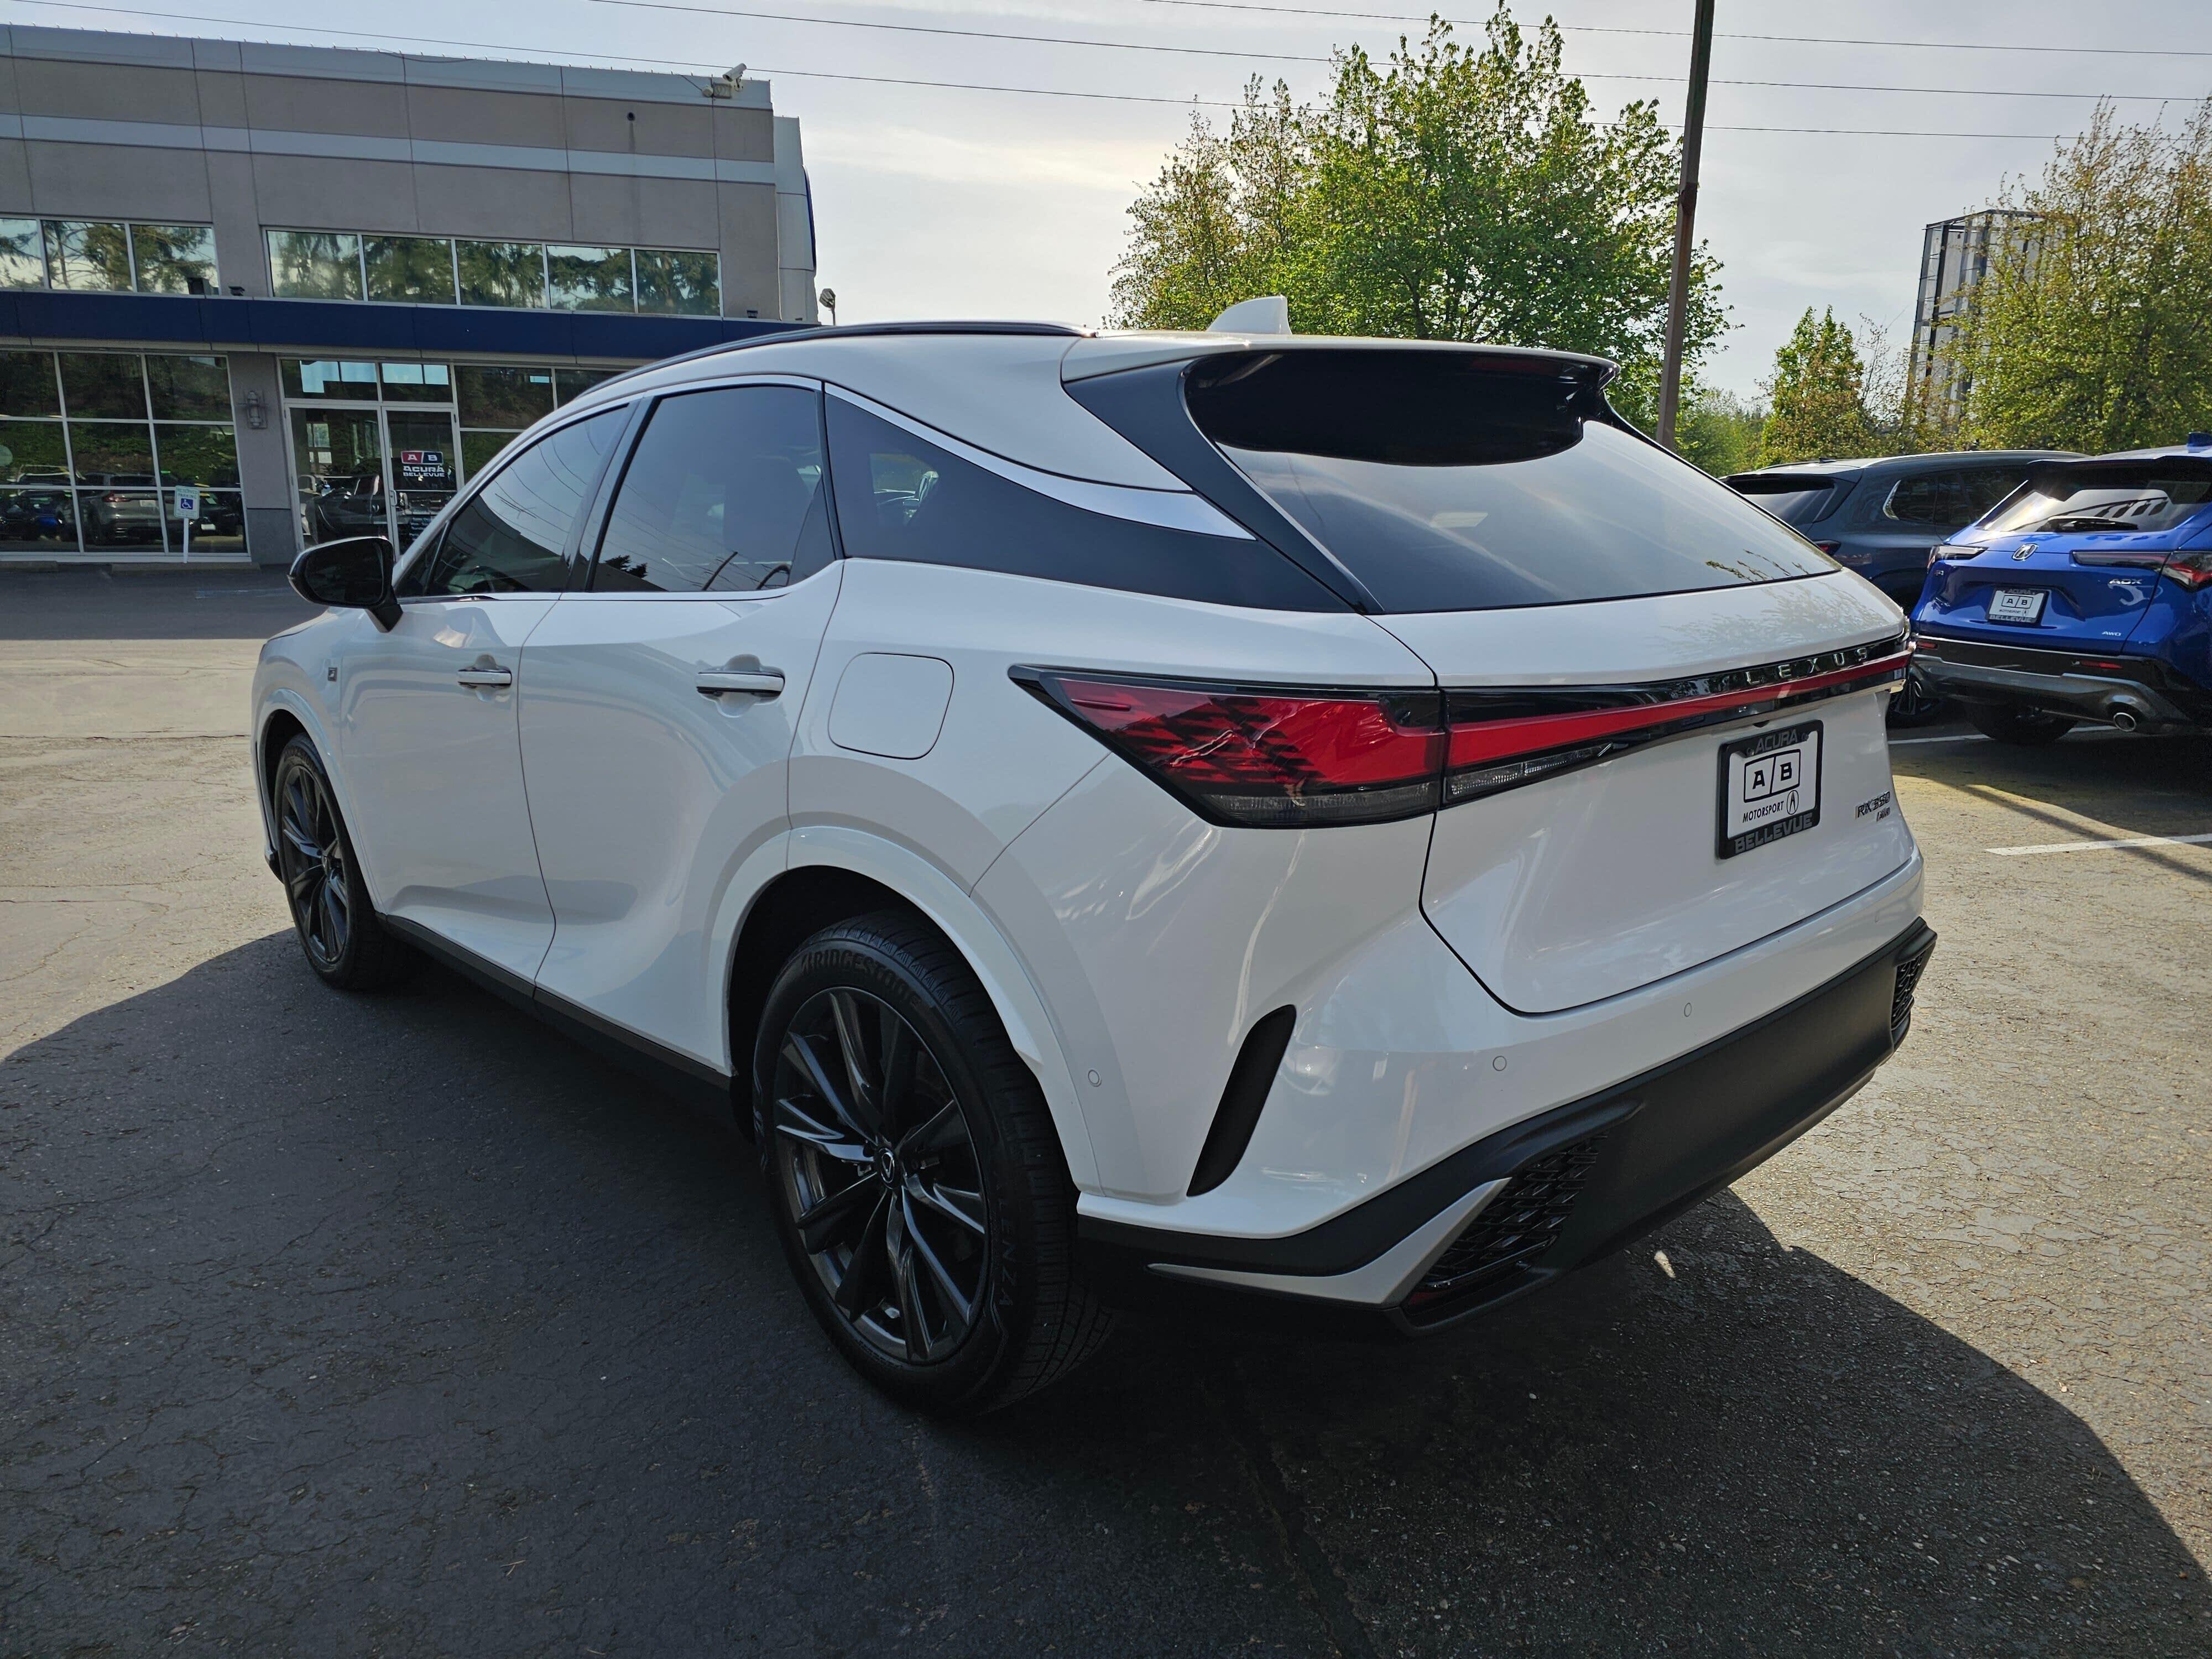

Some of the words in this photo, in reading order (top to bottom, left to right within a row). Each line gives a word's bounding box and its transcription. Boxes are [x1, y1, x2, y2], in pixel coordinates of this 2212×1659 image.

[1989, 614, 2032, 623] BELLEVUE
[1745, 647, 1868, 685] LEXUS
[1755, 729, 1798, 754] ACURA
[1752, 770, 1766, 789] A
[1780, 761, 1792, 781] B
[1743, 801, 1785, 823] MOTORSPORT
[1734, 812, 1813, 854] BELLEVUE
[801, 948, 922, 1009] BRIDGESTONE
[993, 1171, 1018, 1306] ALENZA
